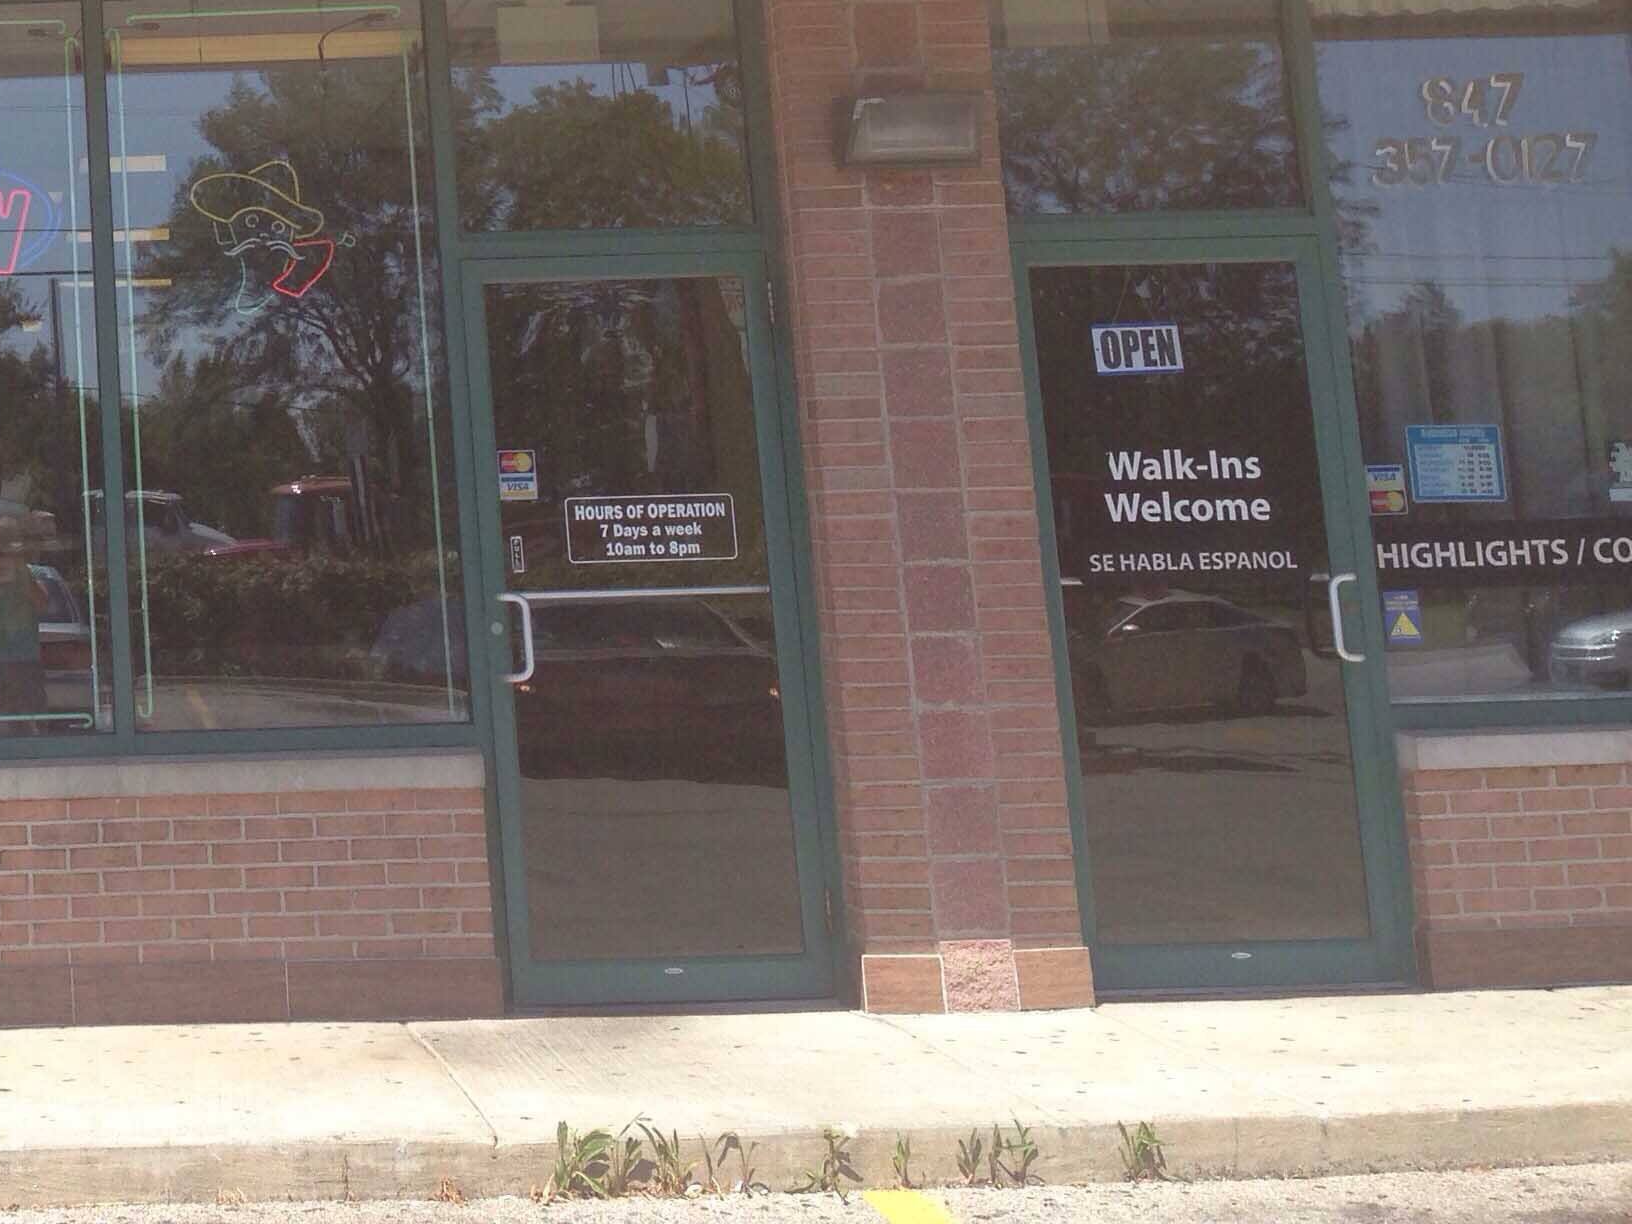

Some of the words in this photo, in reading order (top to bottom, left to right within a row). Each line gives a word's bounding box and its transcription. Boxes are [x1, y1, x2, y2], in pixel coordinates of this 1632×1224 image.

[1421, 73, 1522, 128] 847
[1372, 132, 1599, 189] 357-0127
[1099, 328, 1178, 370] OPEN
[1107, 449, 1261, 480] Walk-Ins
[574, 505, 624, 520] HOURS
[626, 505, 644, 519] OF
[647, 503, 726, 518] OPERATION
[1104, 491, 1271, 522] Welcome
[599, 524, 609, 538] 7
[613, 524, 649, 539] Days
[652, 526, 661, 536] a
[665, 522, 703, 536] week
[606, 542, 646, 556] 10am
[649, 542, 665, 555] to
[669, 541, 701, 556] 8pm
[1089, 554, 1115, 572] SE
[1120, 553, 1194, 571] HABLA
[1199, 551, 1298, 570] ESPANOL
[1376, 539, 1569, 569] HIGHLIGHTS
[1577, 538, 1585, 565] /
[1593, 537, 1632, 564] CO
